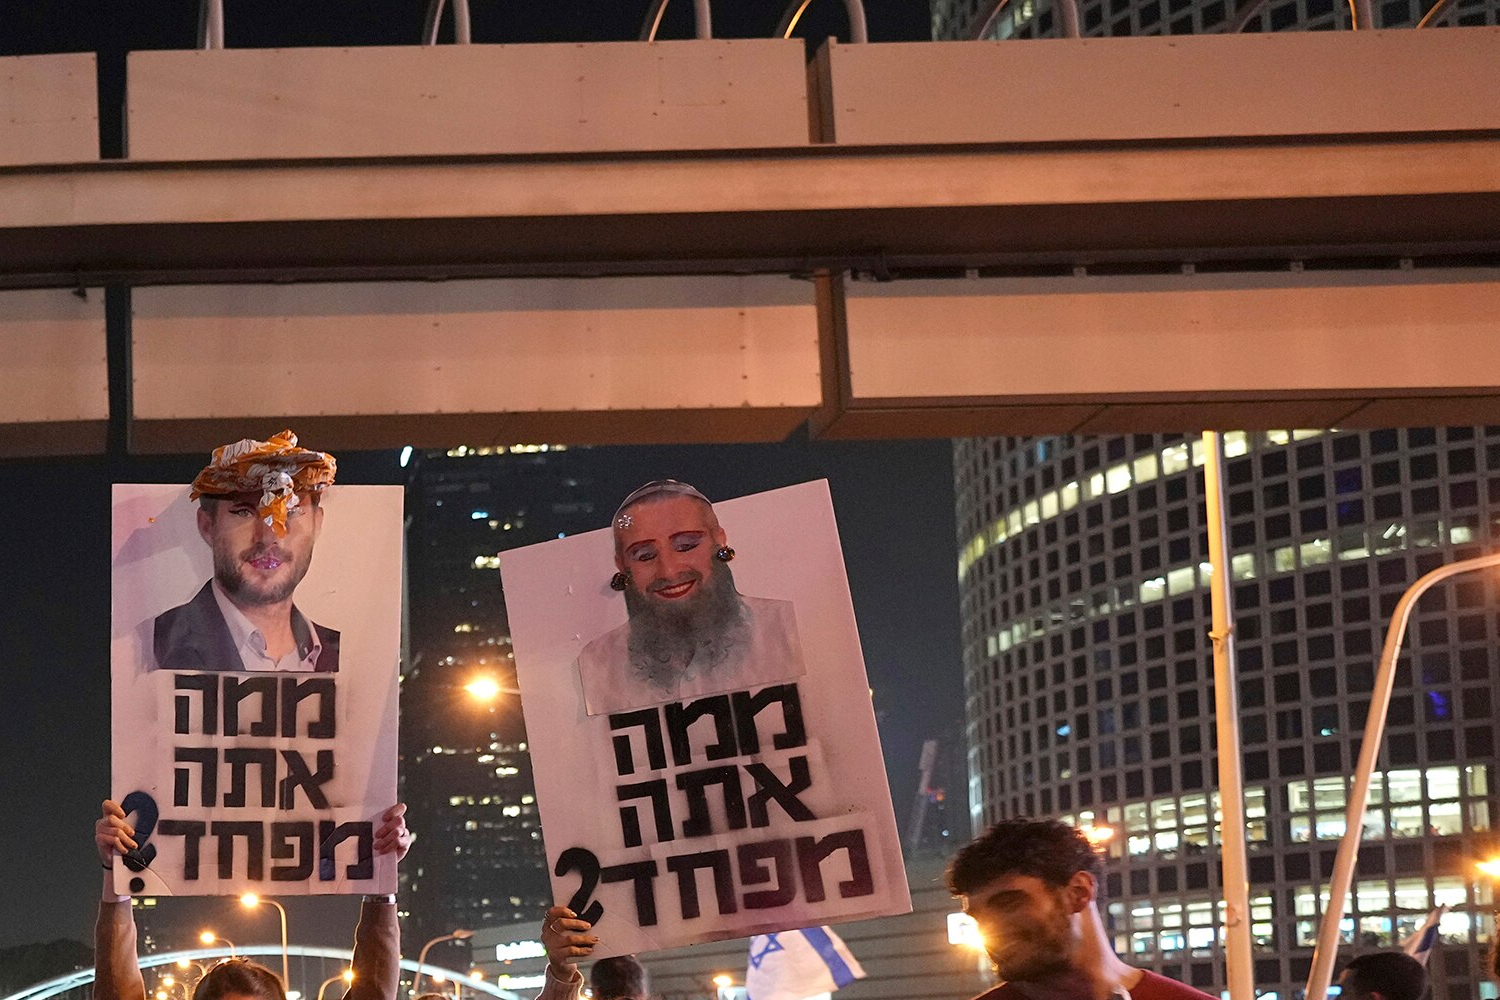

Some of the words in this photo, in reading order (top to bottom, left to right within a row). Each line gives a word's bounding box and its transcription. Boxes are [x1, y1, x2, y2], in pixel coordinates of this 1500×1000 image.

[174, 673, 336, 739] ממה
[608, 682, 807, 776] ממה
[173, 747, 336, 810] אתה
[616, 755, 818, 848] אתה
[120, 790, 375, 893] מפחד?
